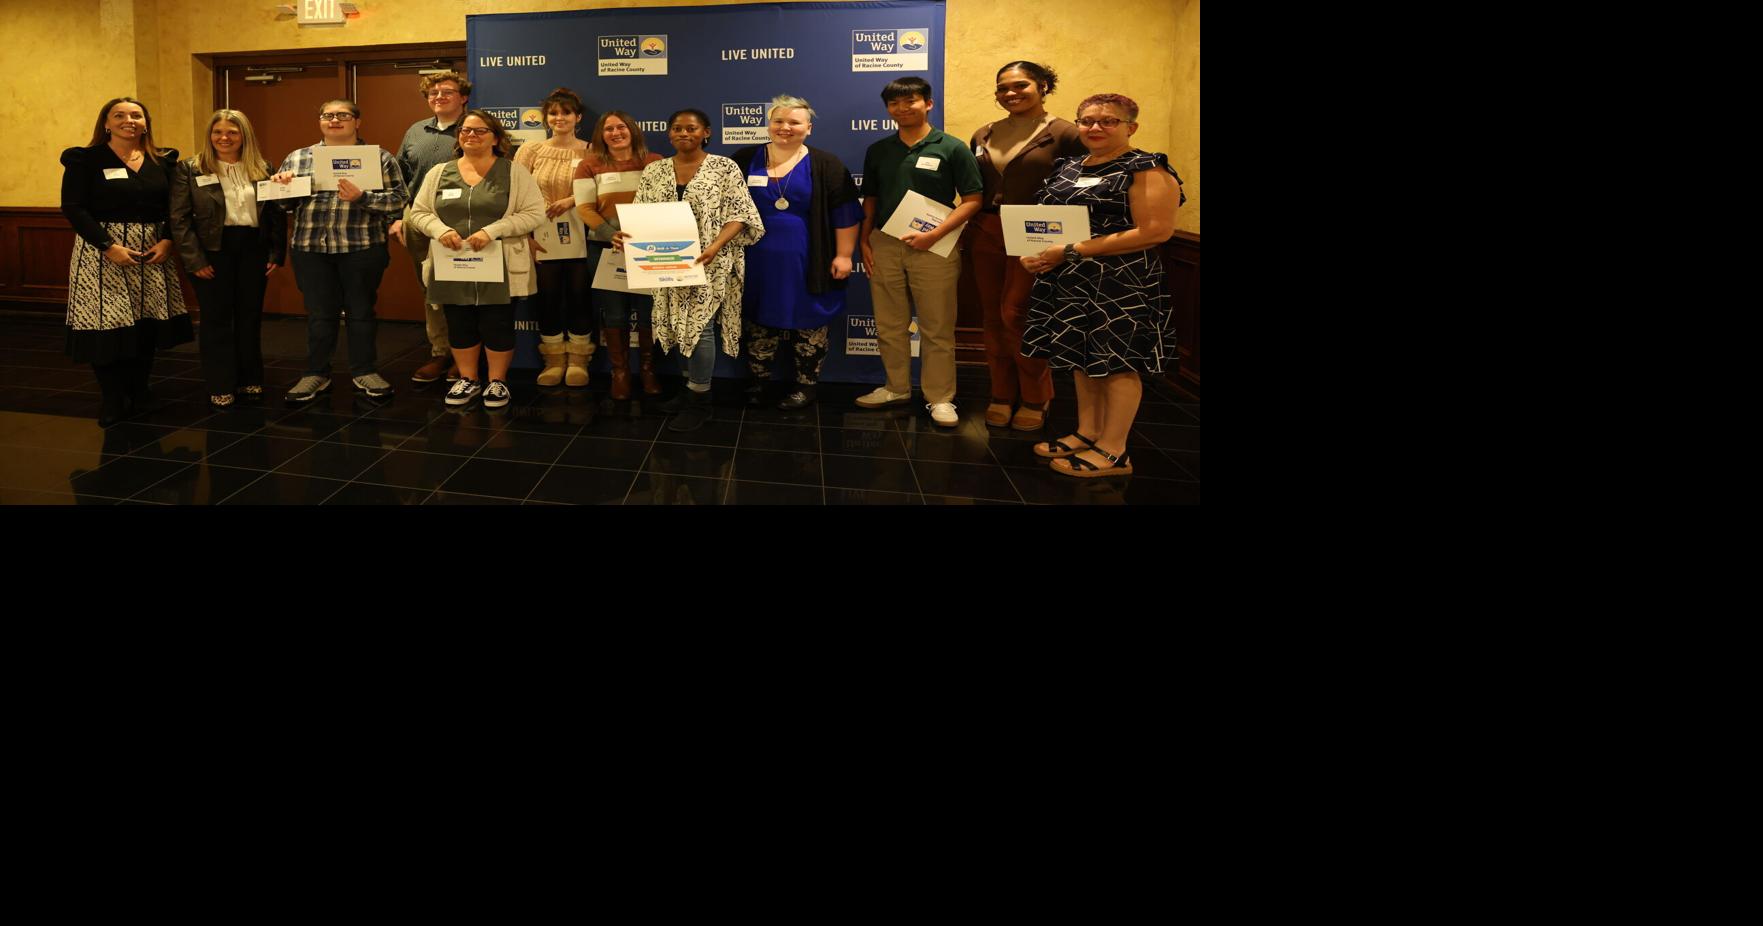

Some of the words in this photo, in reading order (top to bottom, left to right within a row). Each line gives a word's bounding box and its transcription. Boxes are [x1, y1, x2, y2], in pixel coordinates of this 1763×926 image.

[304, 0, 335, 19] EXIT
[855, 32, 895, 42] United
[600, 38, 637, 48] United
[870, 41, 895, 53] Way
[614, 47, 637, 58] Way
[721, 49, 747, 61] LIVE
[751, 47, 794, 60] UNITED
[480, 56, 503, 67] LIVE
[506, 55, 546, 67] UNITED
[484, 110, 518, 119] nited
[724, 105, 763, 116] United
[739, 115, 763, 126] Way
[851, 119, 878, 131] LIVE
[634, 121, 667, 132] NITED
[850, 318, 876, 327] Unit
[864, 327, 878, 336] Wa
